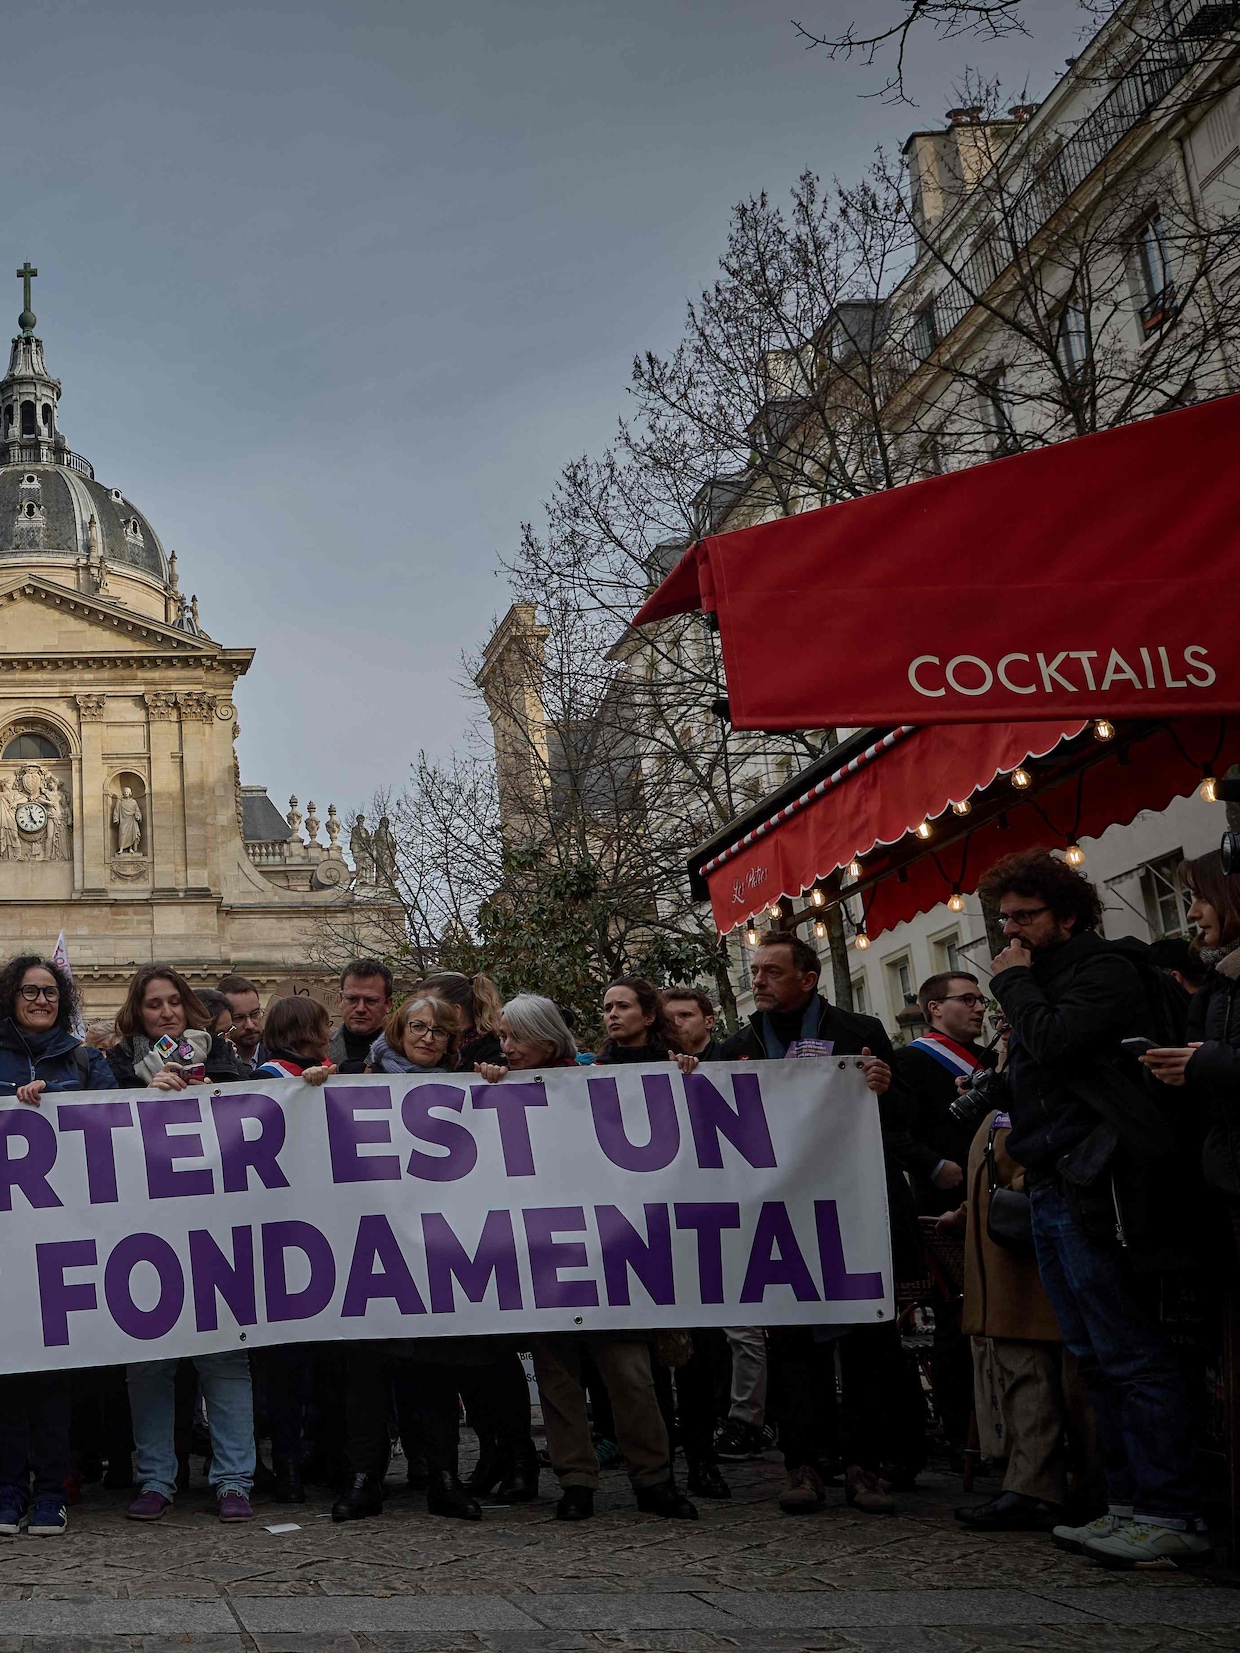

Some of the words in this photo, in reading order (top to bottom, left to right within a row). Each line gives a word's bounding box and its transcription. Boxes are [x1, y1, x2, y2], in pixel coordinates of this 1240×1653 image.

[908, 645, 1217, 697] COCKTAILS
[324, 1082, 548, 1184] EST
[587, 1072, 778, 1173] UN
[36, 1200, 884, 1347] FONDAMENTAL
